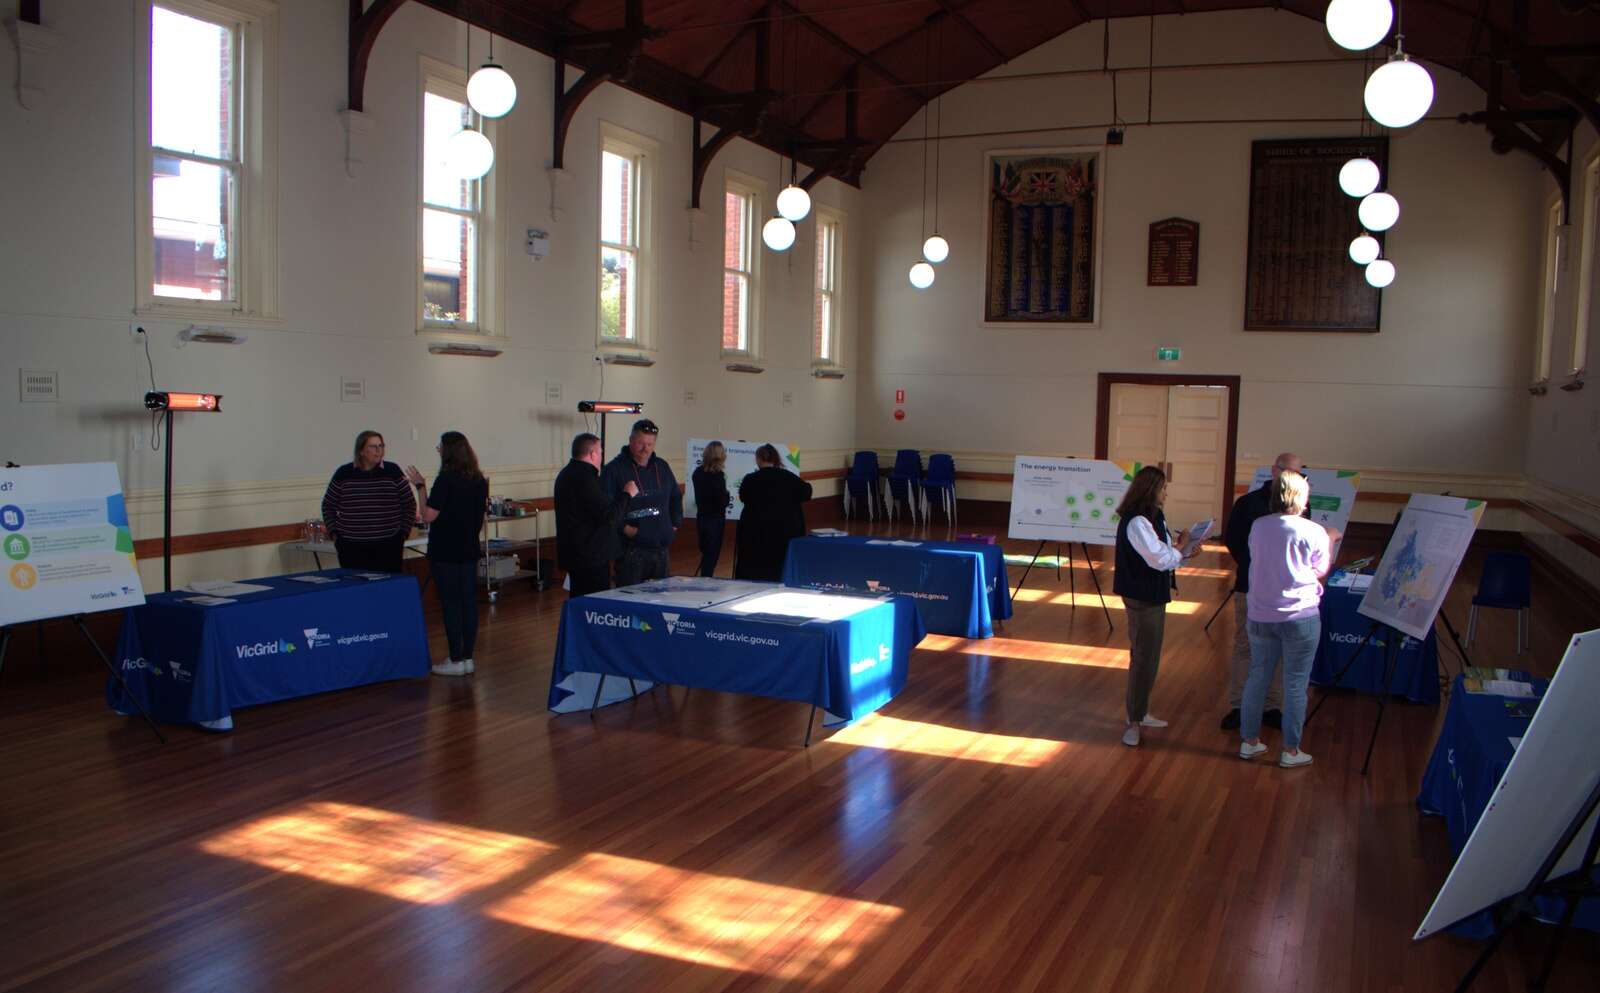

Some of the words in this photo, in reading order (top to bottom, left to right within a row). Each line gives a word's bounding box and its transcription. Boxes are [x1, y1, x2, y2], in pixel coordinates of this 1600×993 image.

[1034, 465, 1057, 473] energy
[1058, 465, 1091, 473] transition
[585, 611, 630, 628] VicGrid
[705, 630, 779, 647] vicgrid.vic.gov.au
[236, 641, 279, 658] VicGrid
